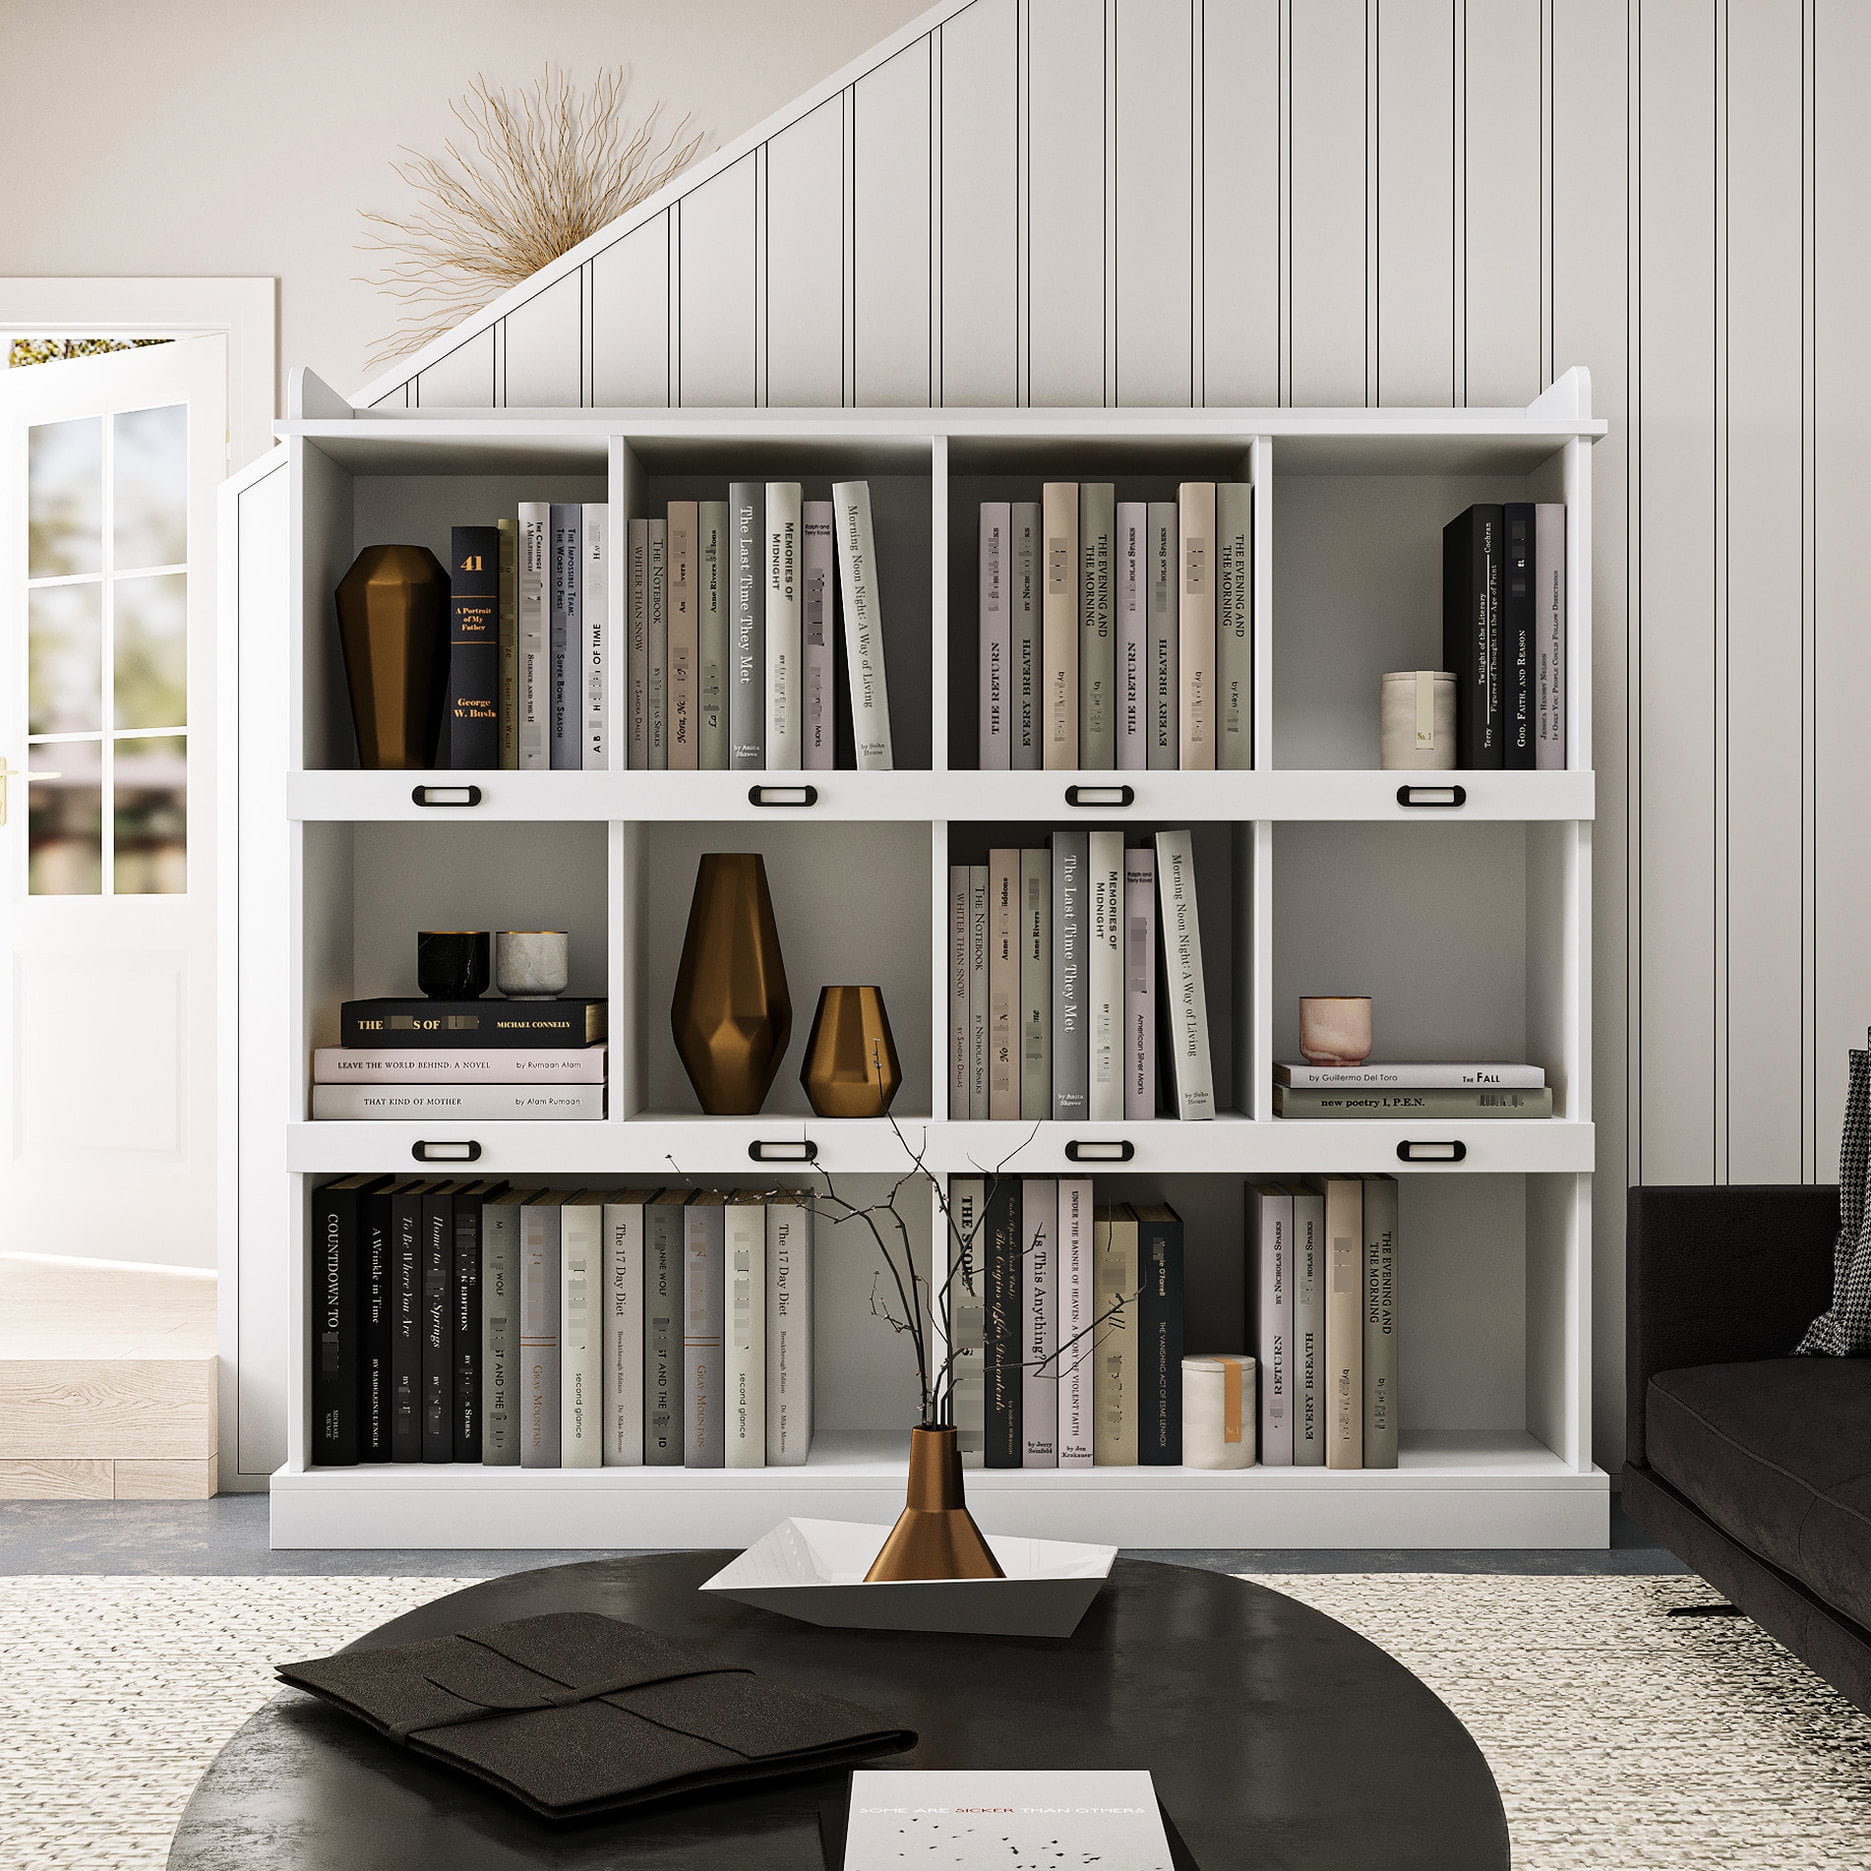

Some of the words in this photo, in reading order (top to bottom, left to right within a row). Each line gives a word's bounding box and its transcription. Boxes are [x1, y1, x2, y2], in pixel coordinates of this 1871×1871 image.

[740, 507, 752, 533] The
[848, 505, 860, 551] Morning
[740, 538, 752, 569] Last
[785, 522, 793, 582] MEMORIES
[1223, 546, 1232, 567] THE
[1236, 535, 1244, 556] THE
[460, 556, 483, 571] 41
[772, 534, 780, 590] MIDNIGHT
[852, 555, 863, 582] Noon
[740, 575, 752, 610] Time
[785, 586, 793, 601] OF
[1235, 561, 1244, 610] EVENING
[853, 586, 867, 621] Night:
[1223, 572, 1232, 626] MORNING
[737, 615, 752, 650] They
[858, 623, 868, 632] A
[1236, 613, 1244, 637] AND
[859, 634, 871, 656] Way
[1479, 641, 1485, 650] of
[740, 655, 751, 682] Met
[862, 660, 871, 670] of
[863, 674, 874, 708] Living
[1231, 681, 1238, 691] by
[454, 710, 467, 718] W.
[470, 710, 496, 718] Bush
[457, 698, 490, 707] George
[1064, 855, 1077, 882] The
[1064, 887, 1077, 918] Last
[1064, 924, 1077, 959] Time
[1062, 965, 1077, 999] They
[358, 1021, 383, 1029] THE
[424, 1021, 440, 1029] OF
[1064, 1005, 1076, 1032] Met
[1309, 1074, 1319, 1082] by
[1346, 1099, 1380, 1108] poetry
[1393, 1099, 1425, 1107] P.E.N.
[373, 1228, 381, 1236] A
[402, 1216, 412, 1231] To
[432, 1216, 443, 1249] Home
[616, 1224, 626, 1246] The
[402, 1233, 412, 1249] Be
[996, 1230, 1005, 1250] The
[1034, 1234, 1046, 1247] Is
[327, 1214, 338, 1305] COUNTDOWN
[372, 1239, 381, 1280] Wrinkle
[433, 1253, 442, 1264] to
[616, 1250, 625, 1262] 17
[402, 1252, 412, 1288] Where
[614, 1267, 625, 1289] Day
[993, 1256, 1005, 1298] Origins
[1034, 1253, 1046, 1283] This
[373, 1285, 381, 1294] in
[1072, 1275, 1079, 1285] OF
[372, 1298, 381, 1324] Time
[402, 1292, 412, 1313] You
[616, 1293, 626, 1316] Diet
[993, 1302, 1006, 1311] of
[328, 1309, 338, 1327] TO
[402, 1316, 411, 1337] Are
[430, 1302, 443, 1349] Springs
[1032, 1288, 1046, 1361] Anything?
[373, 1359, 378, 1368] BY
[1305, 1332, 1313, 1388] BREATH
[575, 1408, 583, 1439] glance
[1305, 1394, 1313, 1440] EVERY
